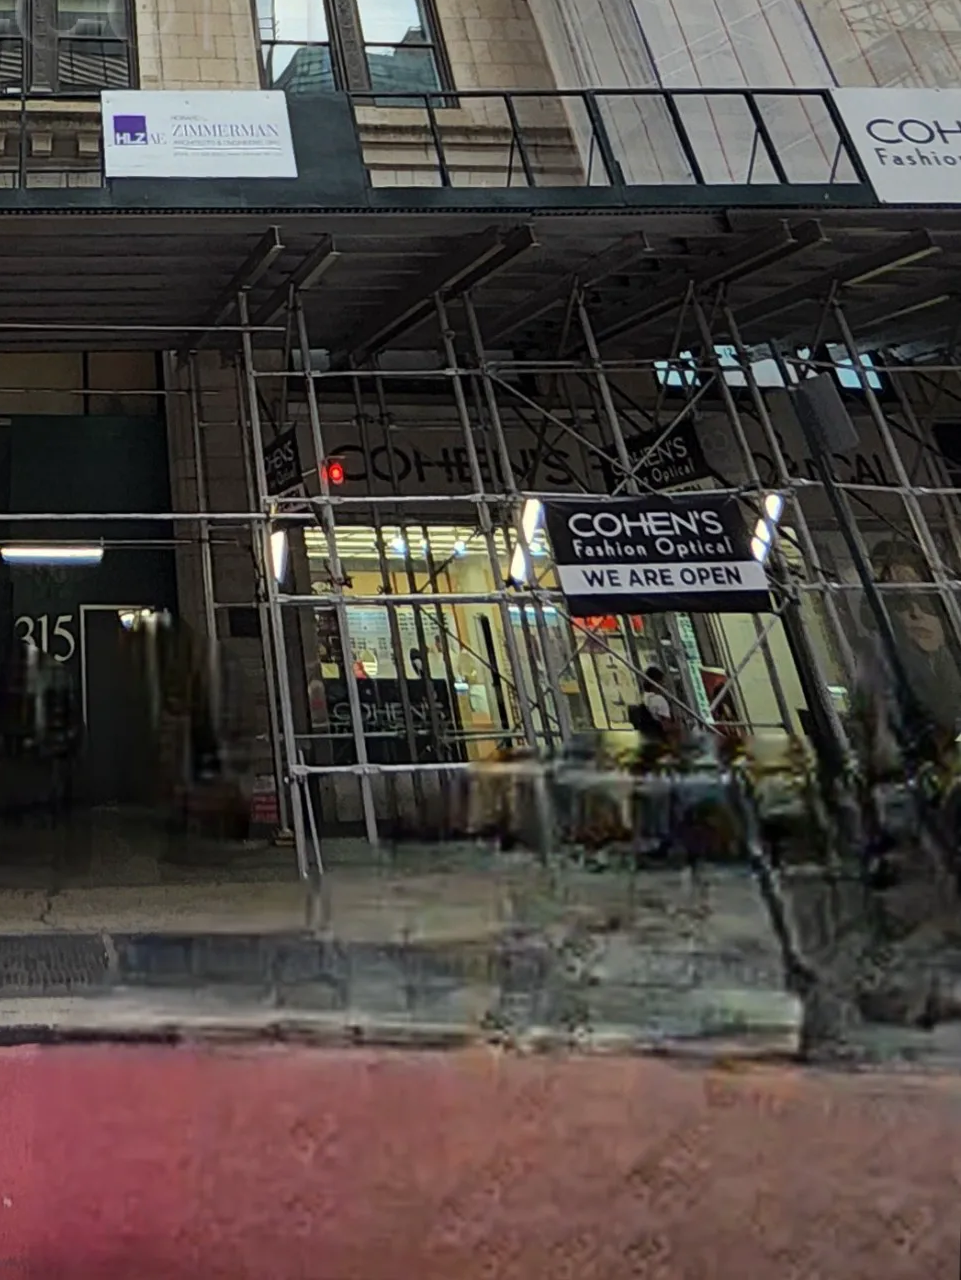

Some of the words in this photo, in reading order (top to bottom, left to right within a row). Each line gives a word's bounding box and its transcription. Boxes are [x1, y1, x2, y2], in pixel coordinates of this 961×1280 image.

[115, 132, 148, 145] HLZ
[172, 123, 279, 138] ZIMMERMAN
[874, 147, 961, 166] Fashio
[568, 510, 724, 538] COHEN'S
[572, 539, 648, 558] Fashion
[655, 535, 734, 559] Optical
[582, 569, 622, 588] WE
[629, 568, 674, 587] ARE
[679, 566, 743, 586] OPEN
[14, 612, 76, 662] 315
